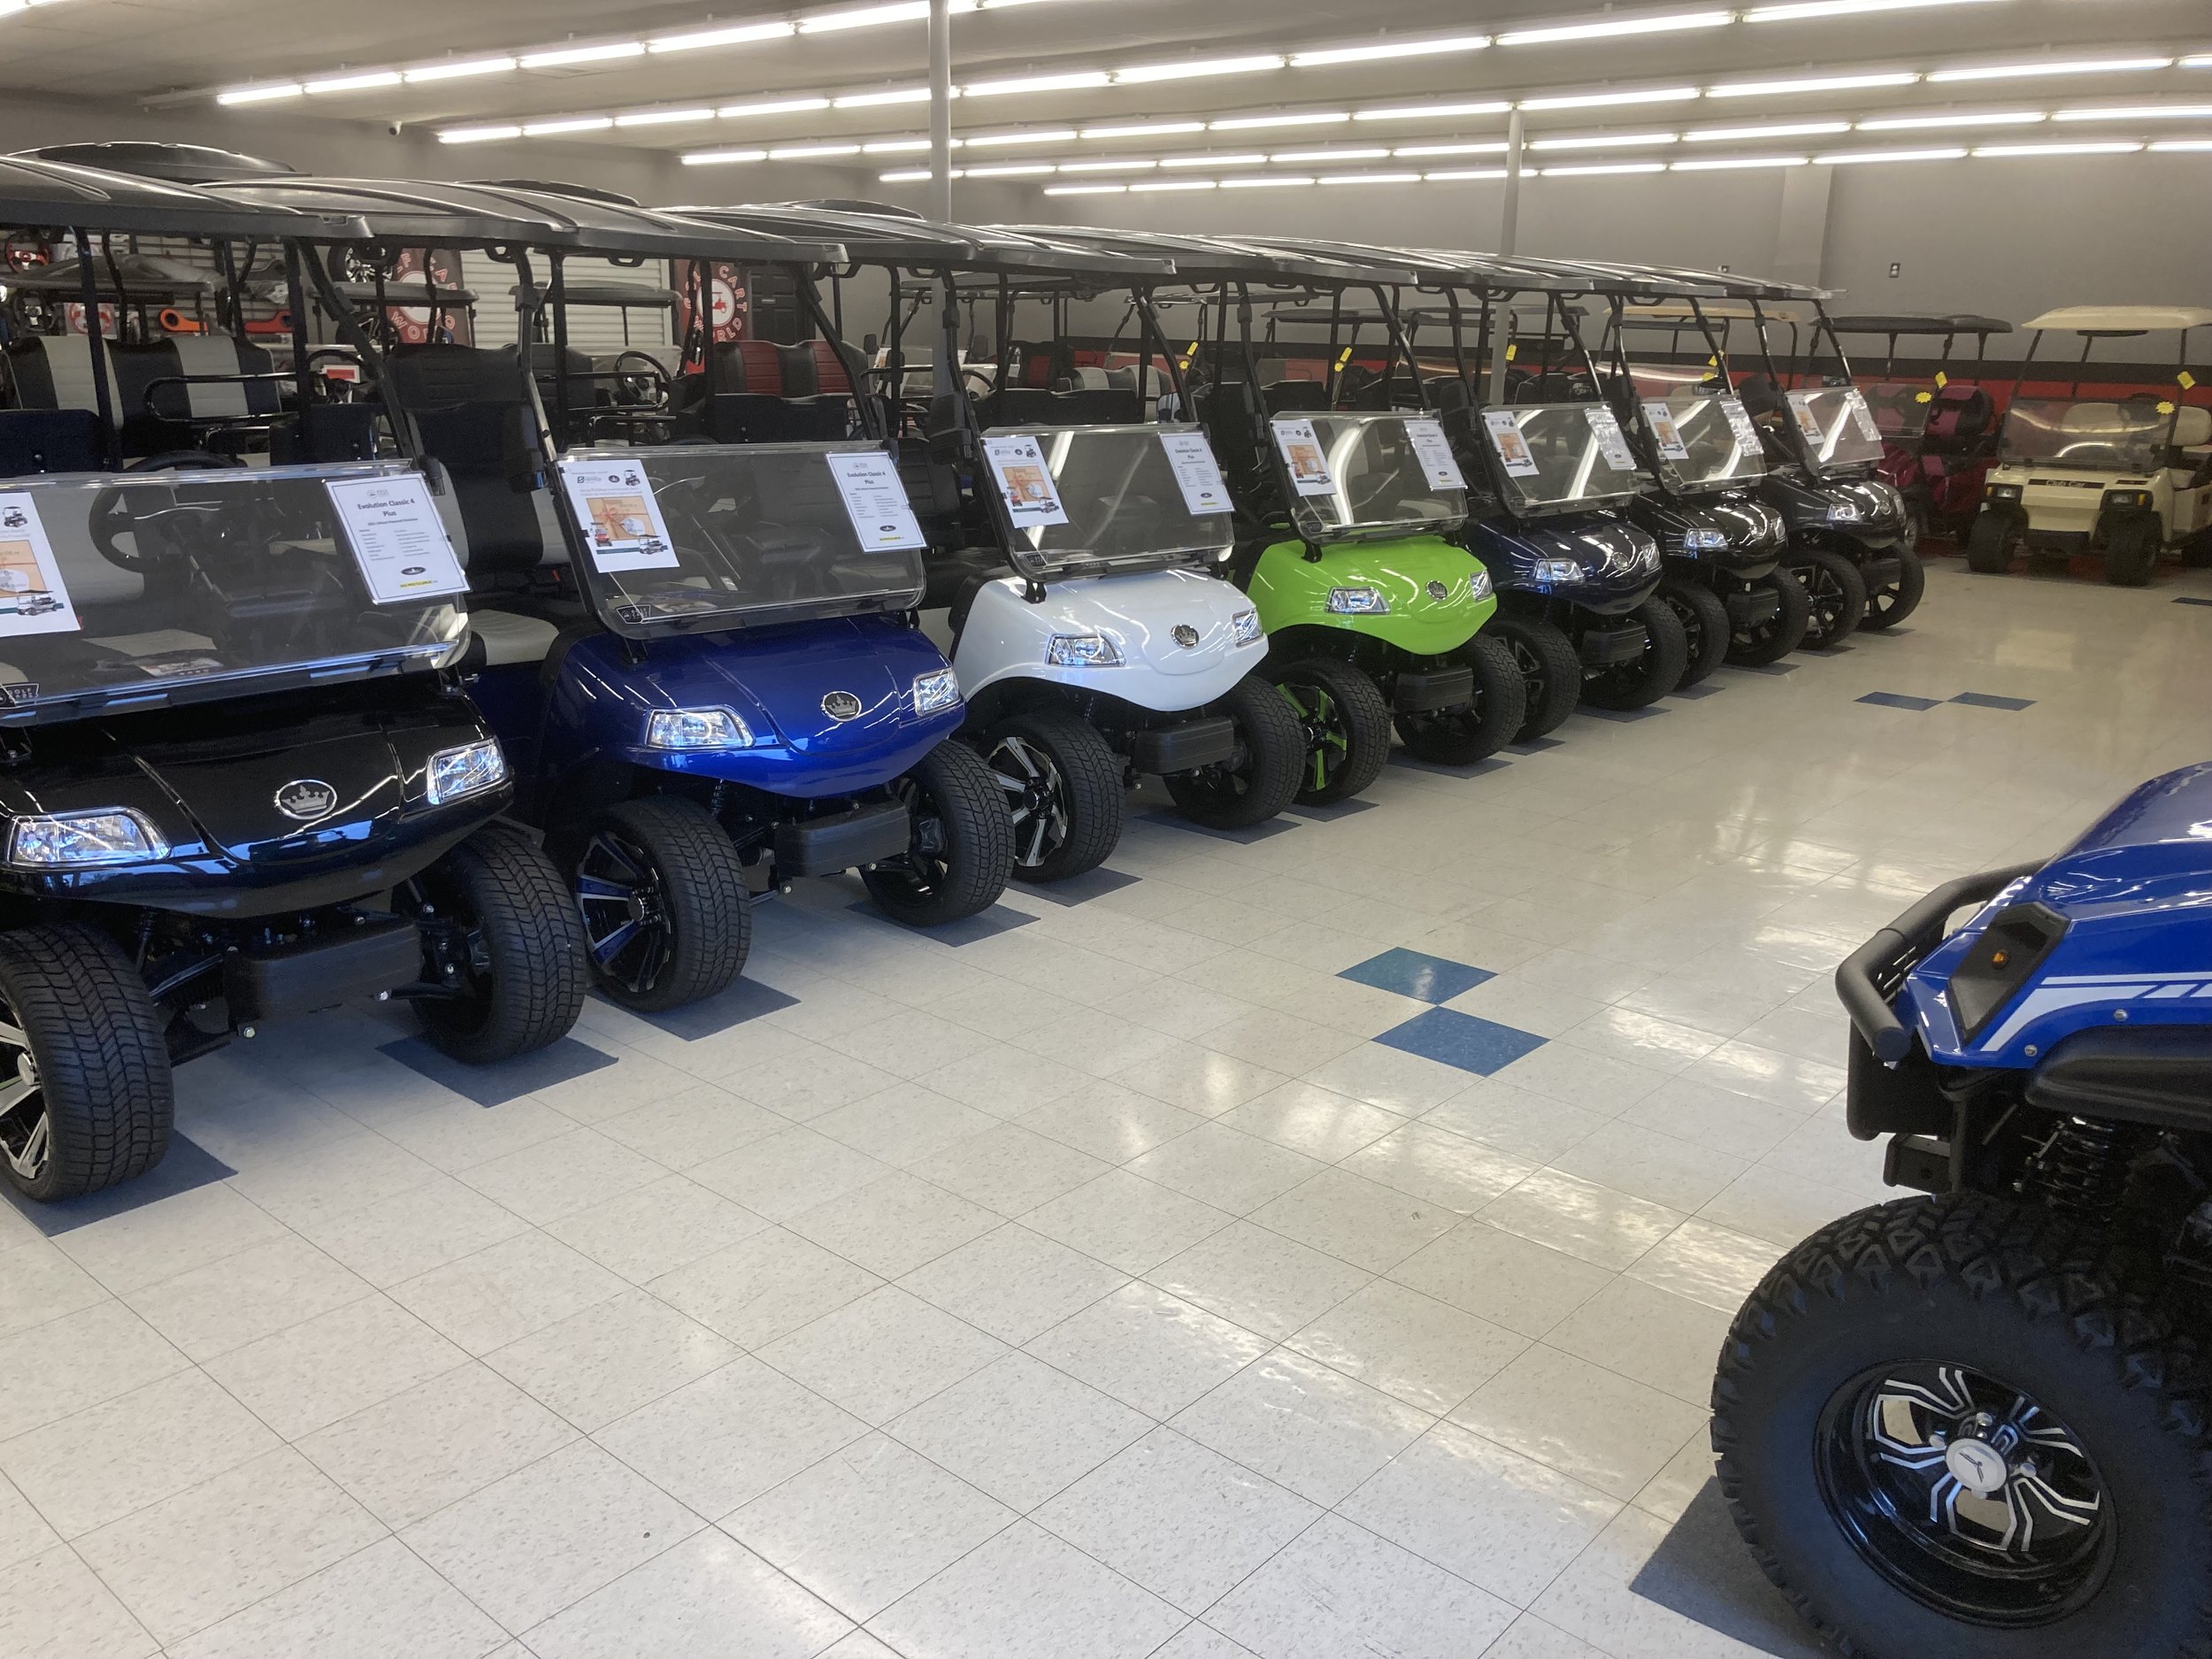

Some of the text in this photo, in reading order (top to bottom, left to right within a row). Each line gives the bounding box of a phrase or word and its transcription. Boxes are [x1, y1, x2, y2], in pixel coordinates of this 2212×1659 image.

[718, 265, 749, 312] CART
[693, 312, 743, 342] WRLD
[357, 501, 388, 511] Evolution
[388, 498, 411, 508] Classic
